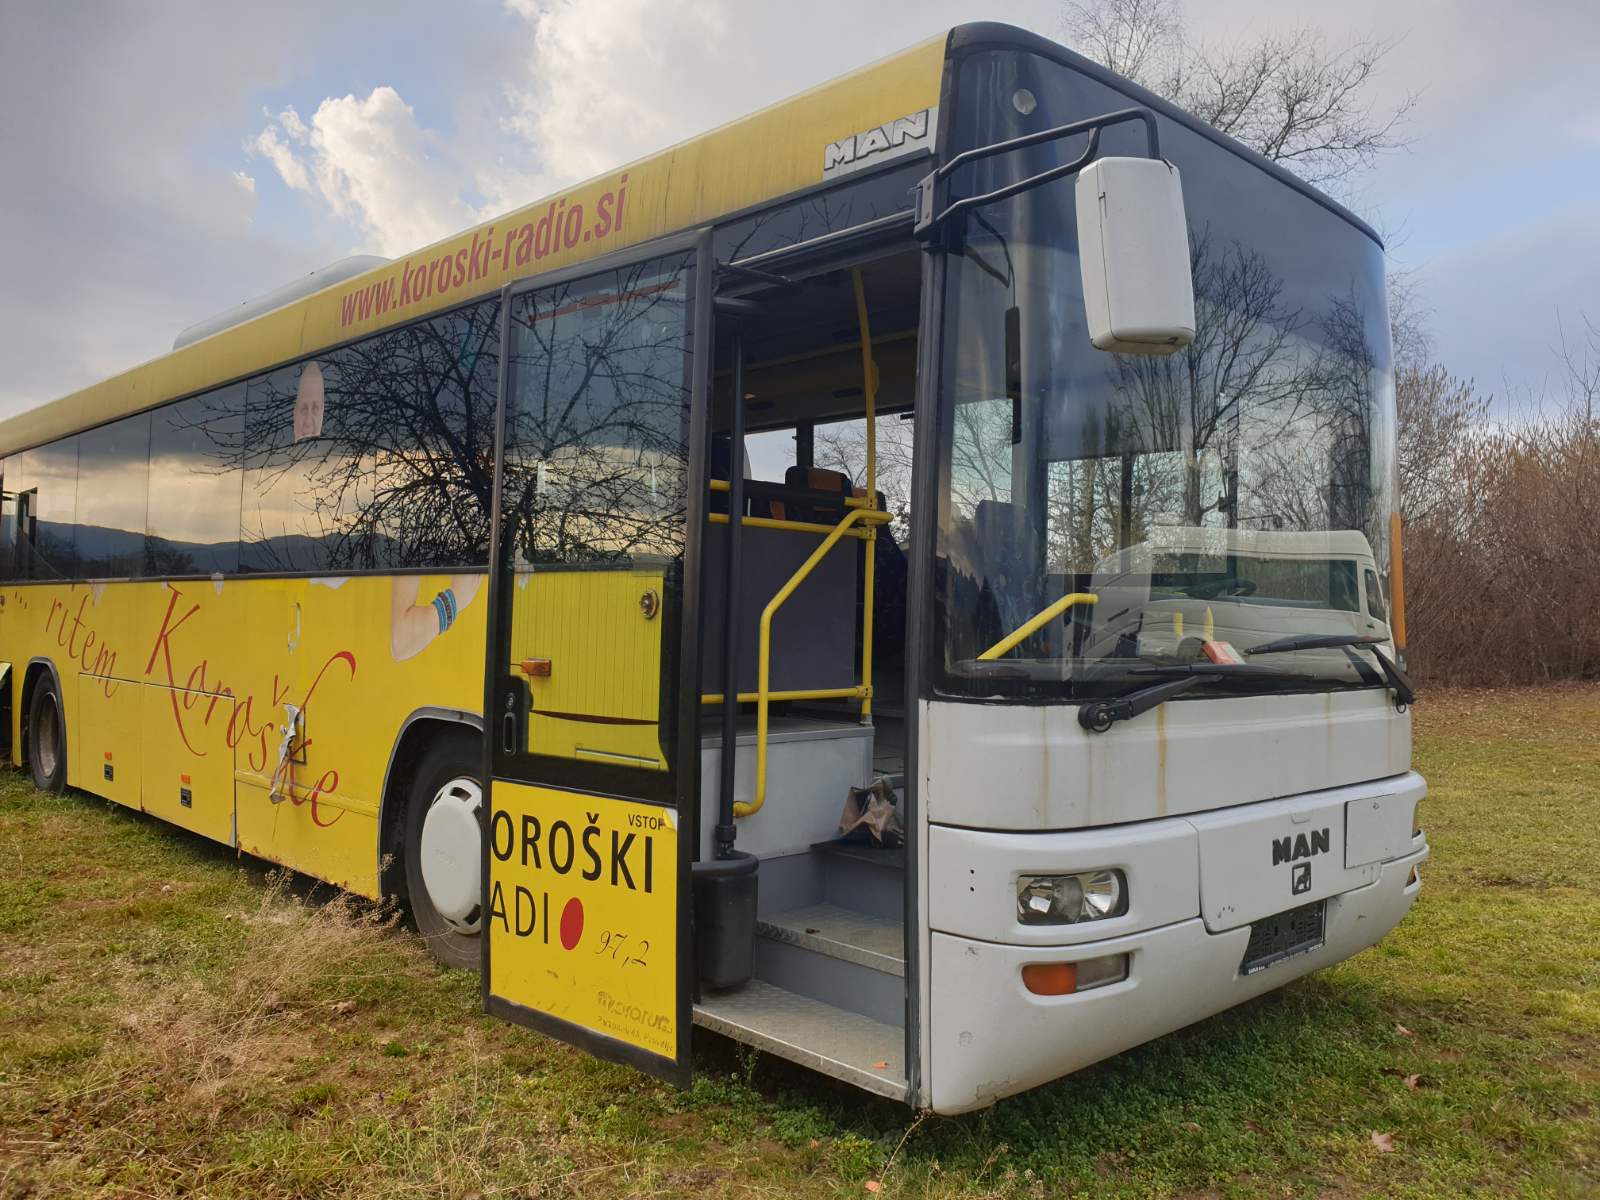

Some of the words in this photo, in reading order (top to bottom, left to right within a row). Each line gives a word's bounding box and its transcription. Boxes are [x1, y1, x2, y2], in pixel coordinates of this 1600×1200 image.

[823, 108, 929, 172] MAN
[341, 173, 630, 328] www.koroski-radio.si
[45, 585, 120, 698] ritem
[1272, 827, 1330, 867] MAN
[595, 929, 650, 968] 97,2
